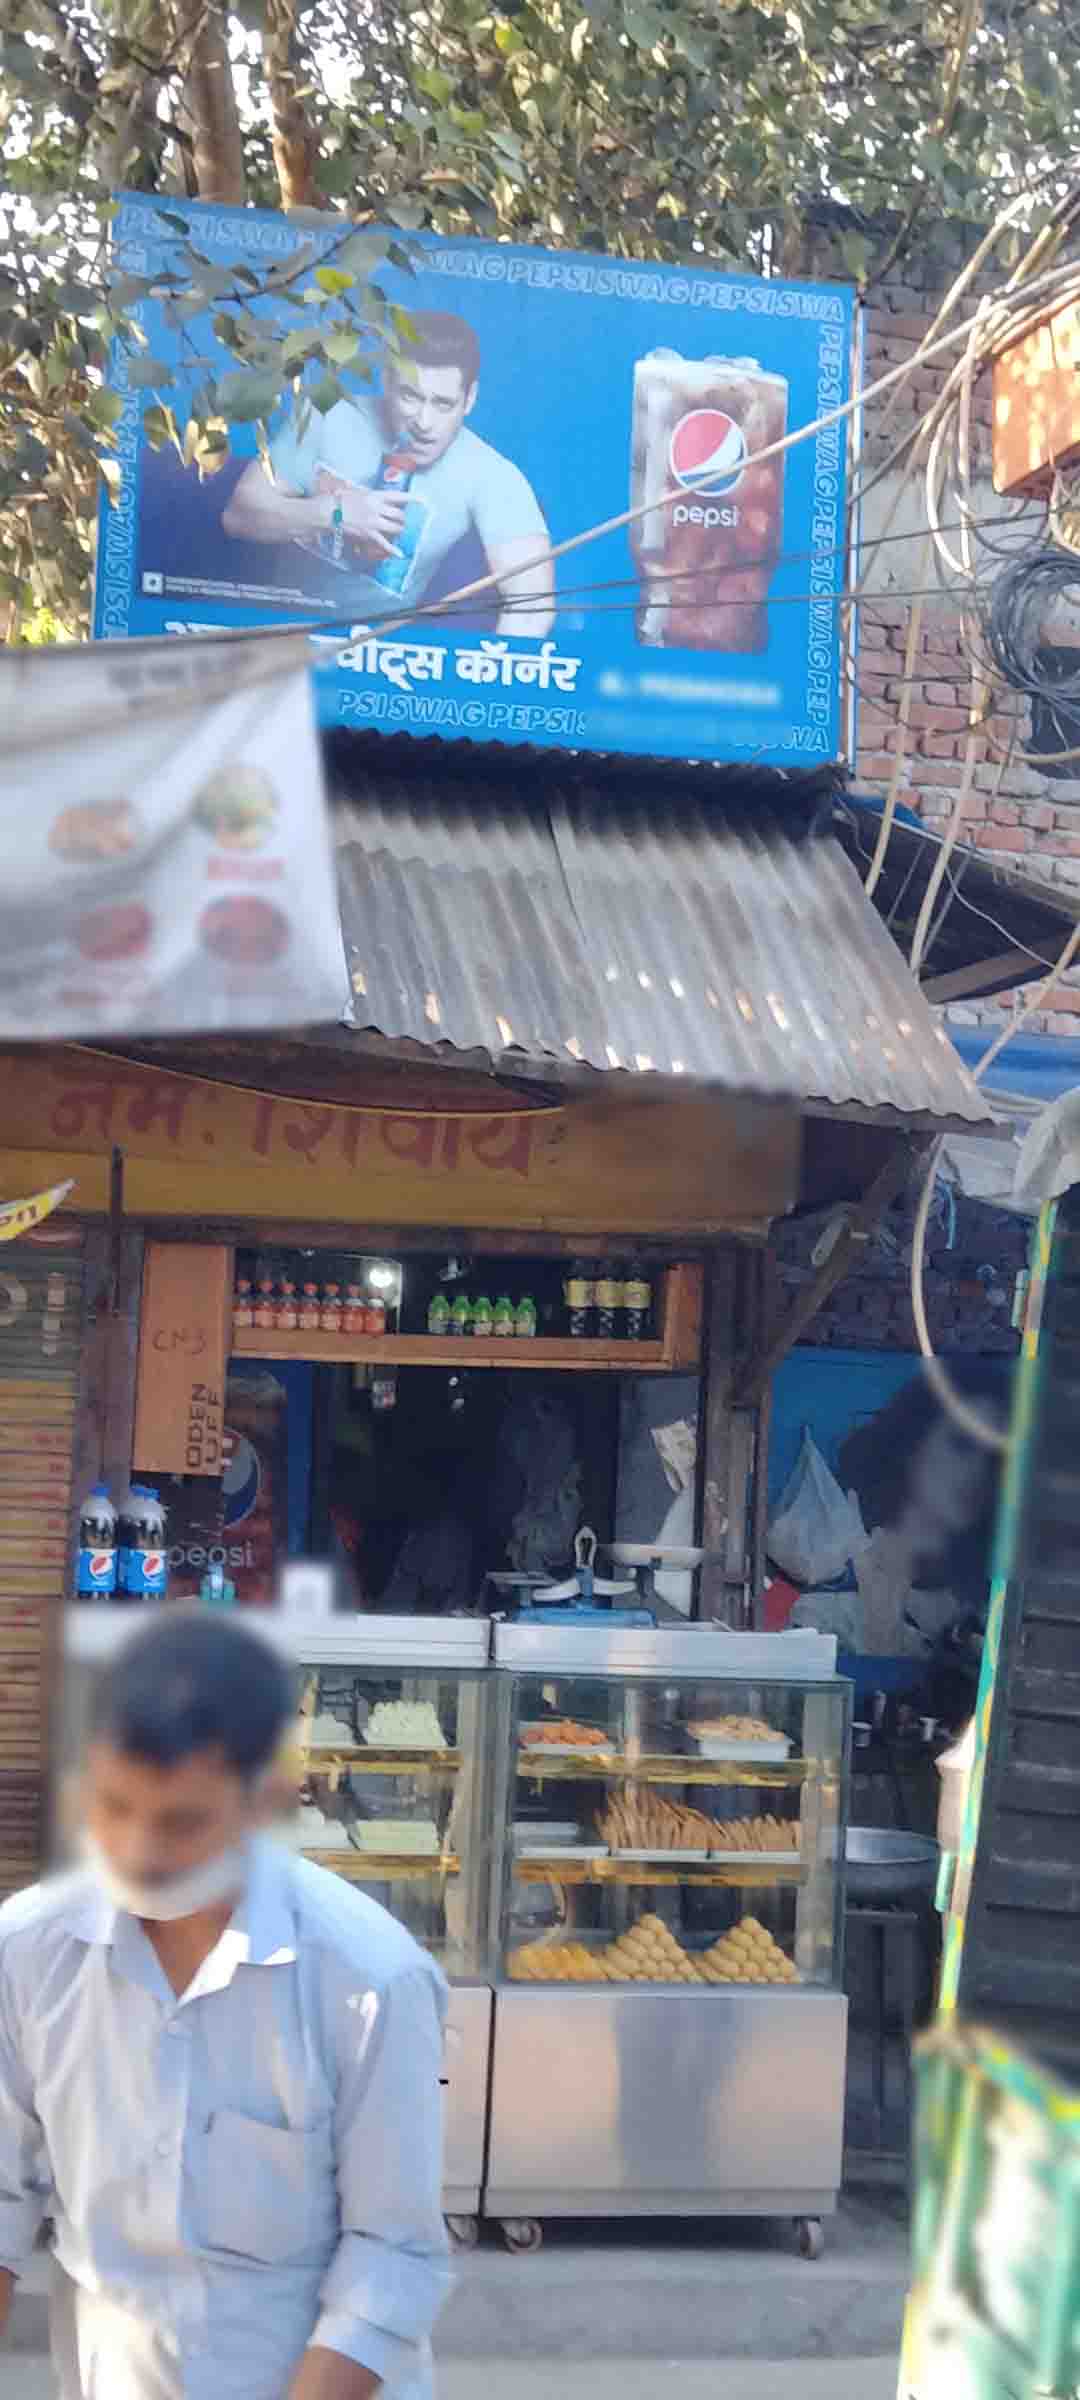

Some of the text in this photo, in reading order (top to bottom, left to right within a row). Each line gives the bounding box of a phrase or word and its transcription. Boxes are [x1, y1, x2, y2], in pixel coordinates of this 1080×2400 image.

[672, 504, 738, 528] pepsi
[308, 624, 447, 691] वीट्स
[455, 640, 582, 692] कॉर्नर
